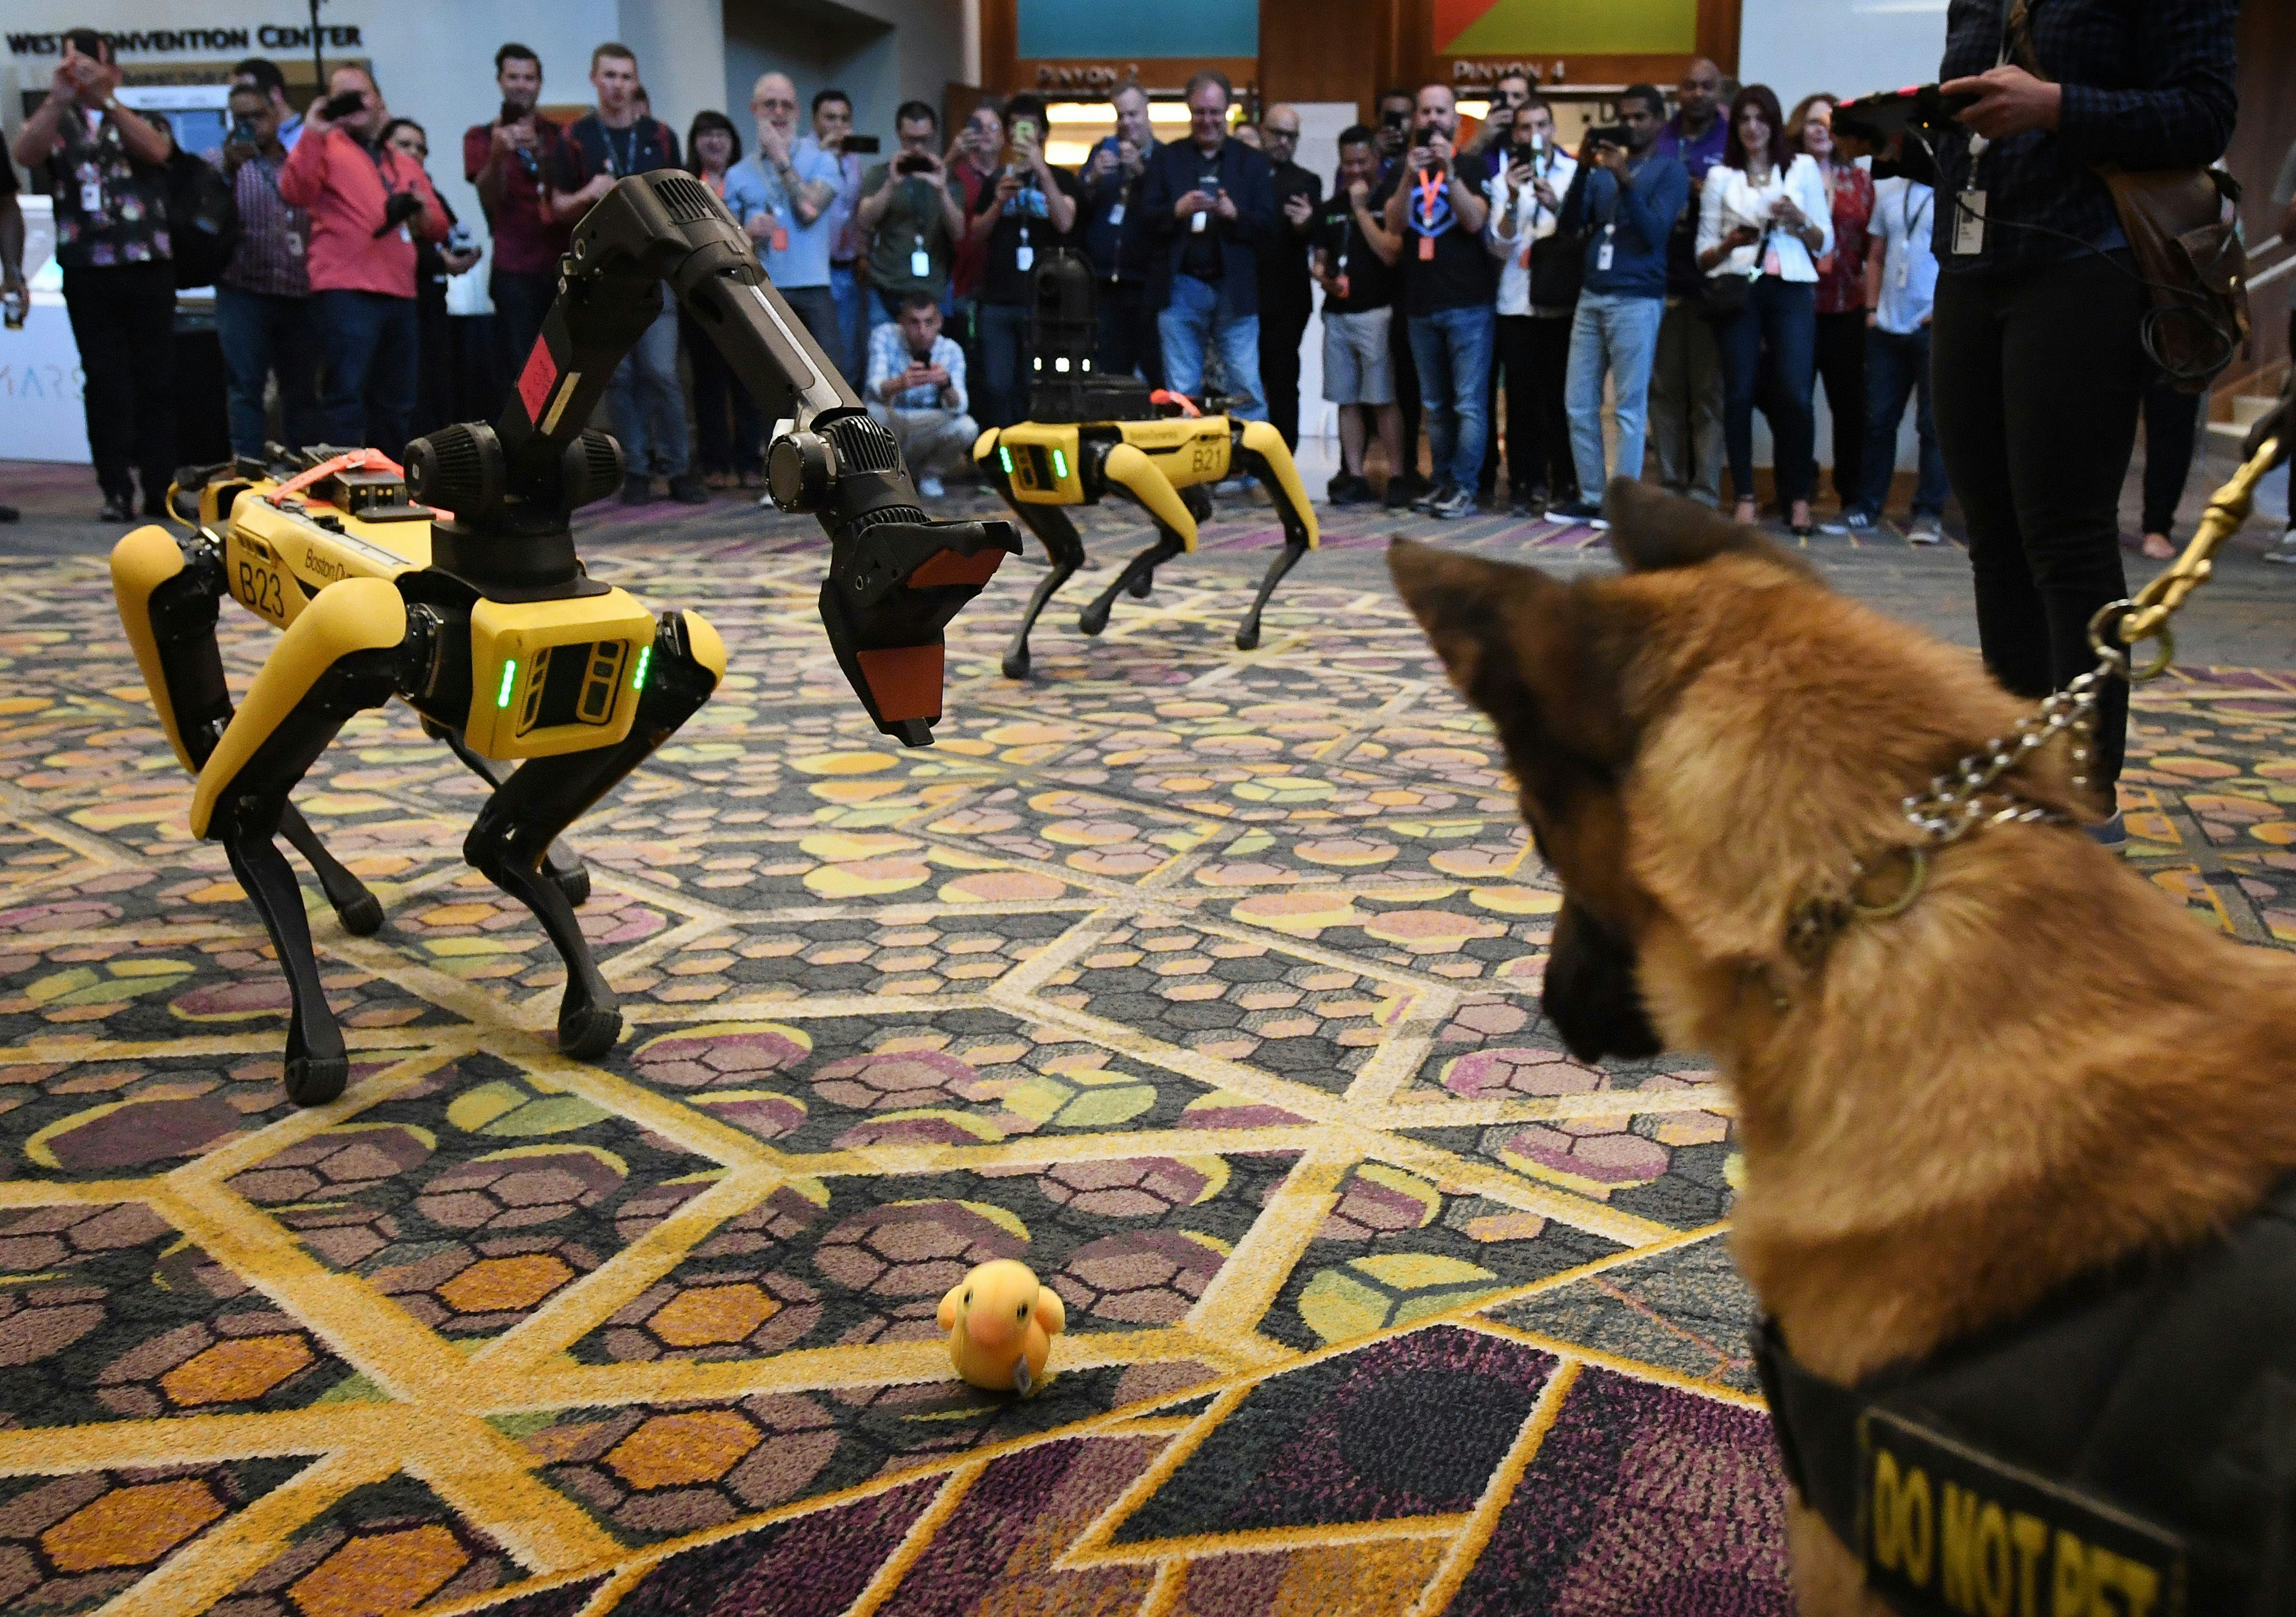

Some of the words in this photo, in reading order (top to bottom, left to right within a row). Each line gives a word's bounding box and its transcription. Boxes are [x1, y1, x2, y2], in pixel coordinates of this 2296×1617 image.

[105, 27, 248, 51] ONVENTION
[1192, 448, 1222, 473] B21
[305, 548, 335, 580] Boston
[239, 561, 285, 618] B23
[1874, 1448, 1933, 1588] DO
[1941, 1480, 2048, 1617] NOT
